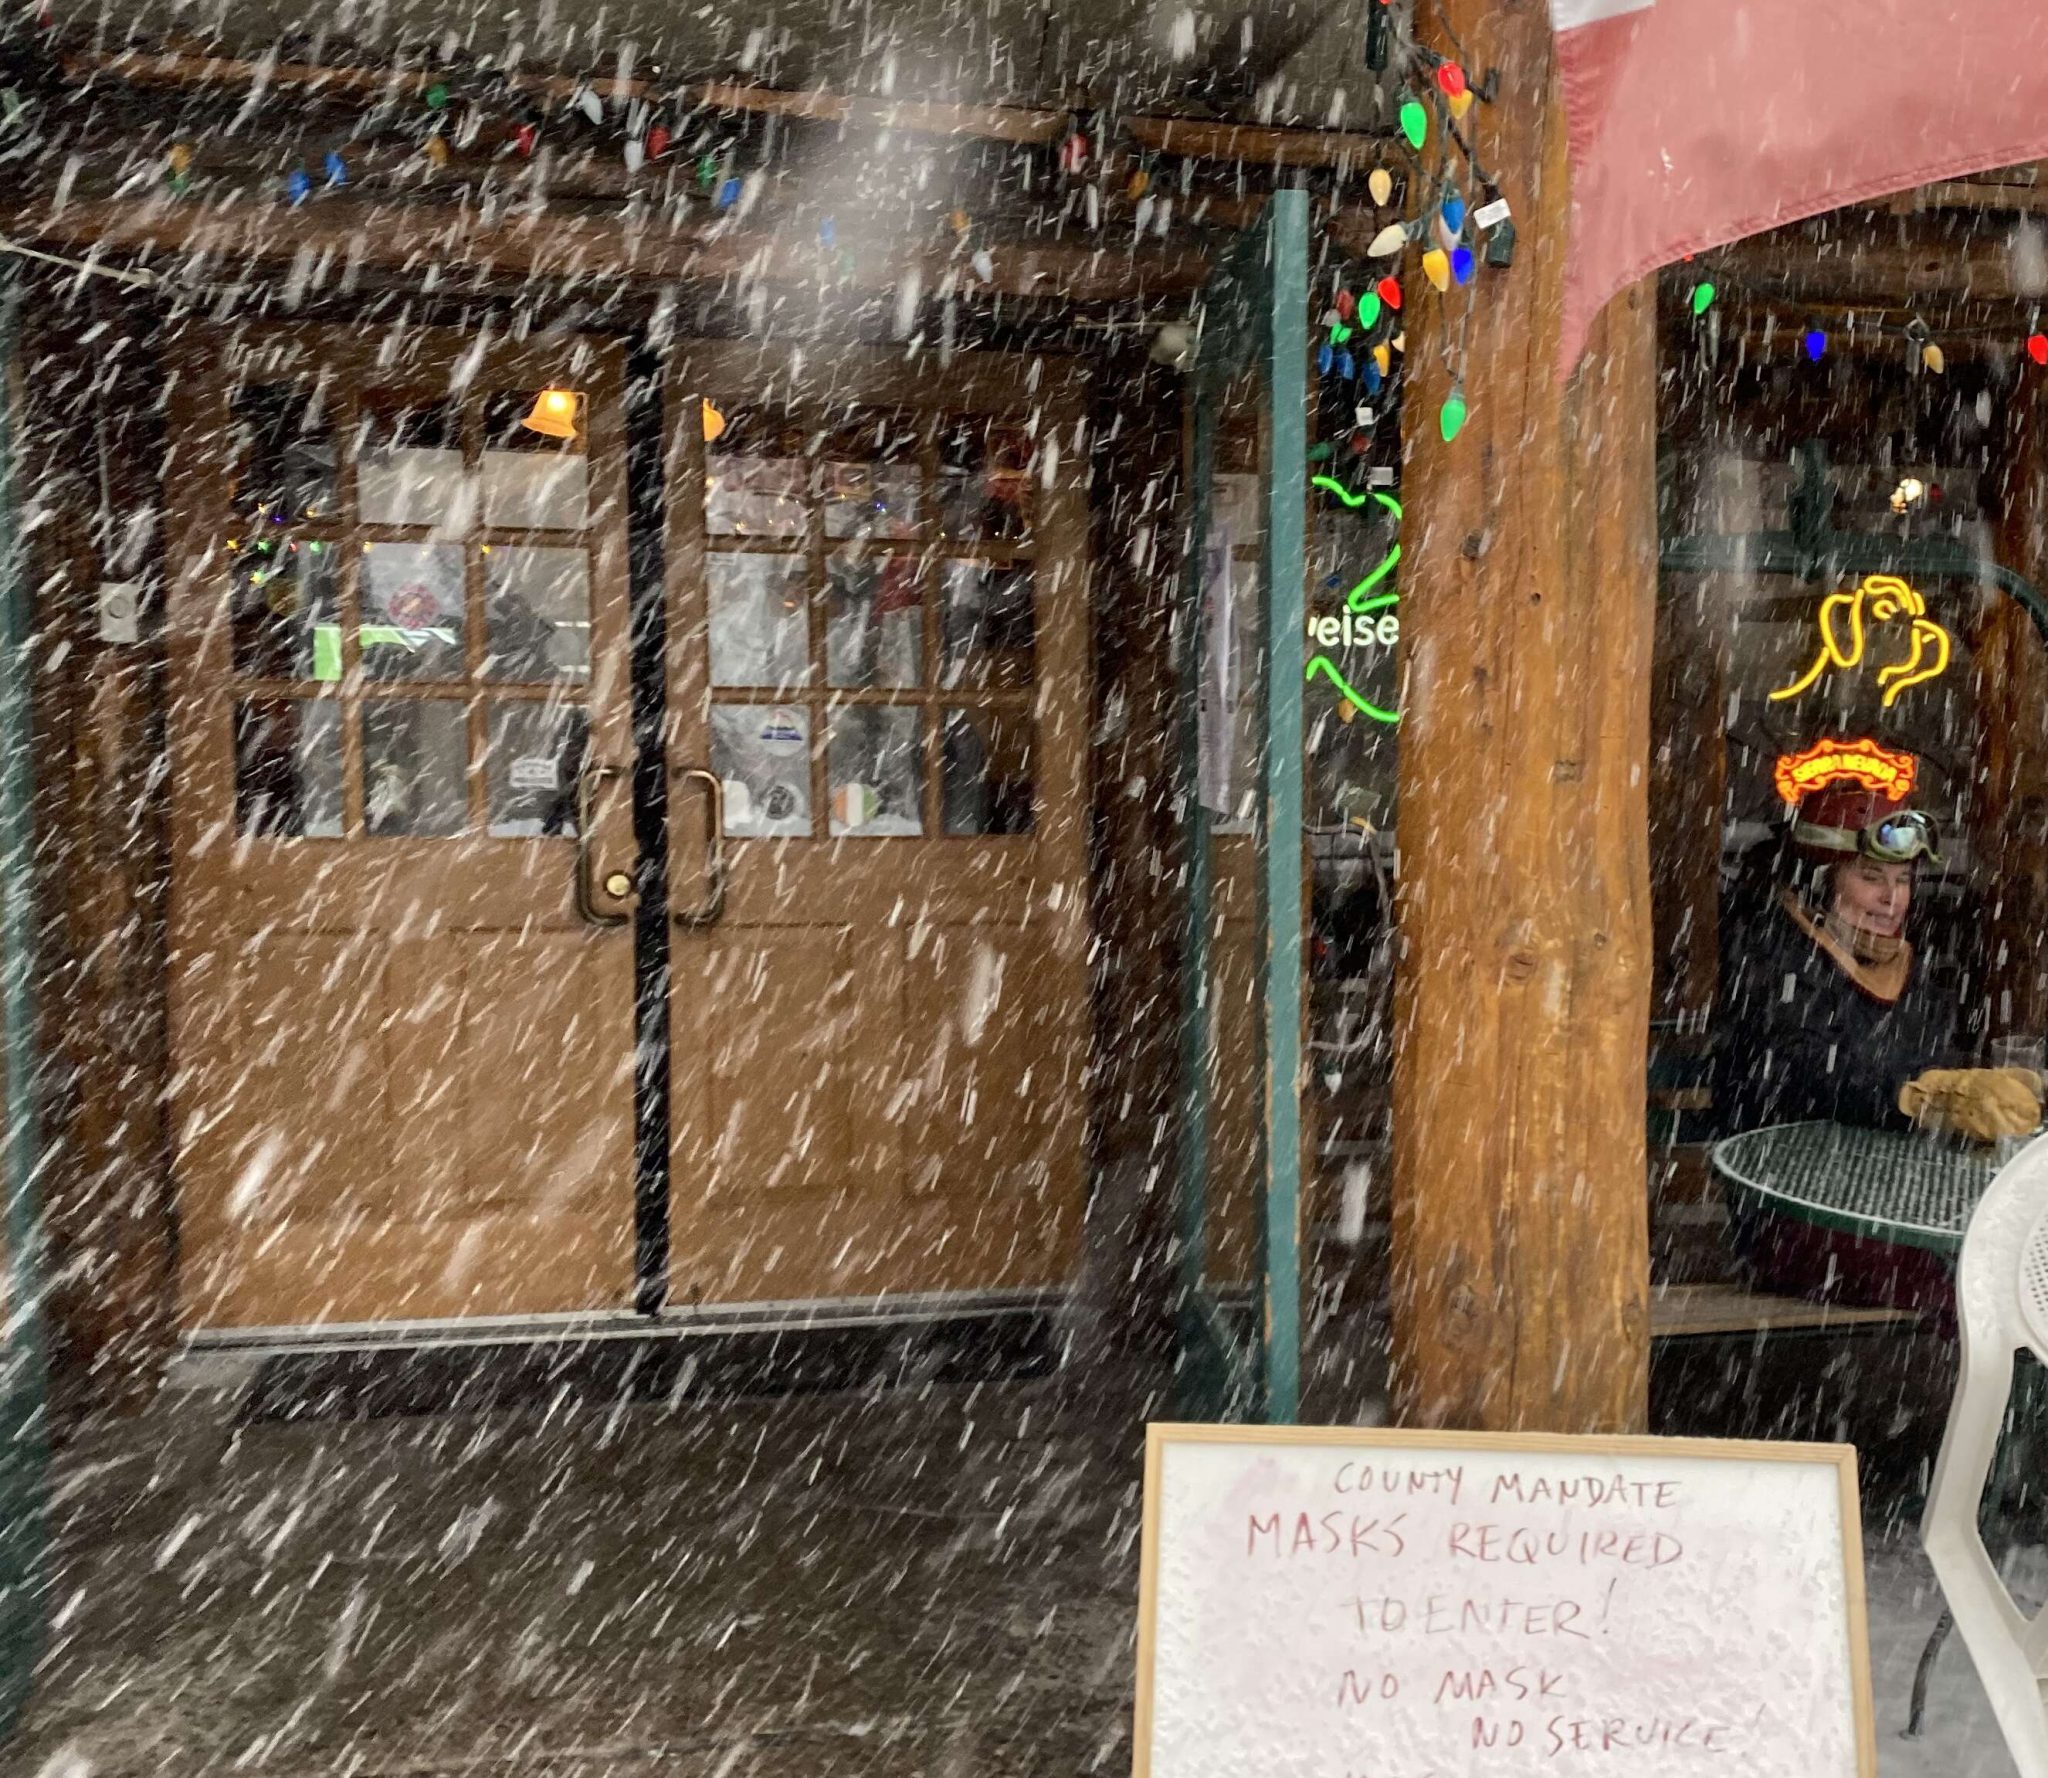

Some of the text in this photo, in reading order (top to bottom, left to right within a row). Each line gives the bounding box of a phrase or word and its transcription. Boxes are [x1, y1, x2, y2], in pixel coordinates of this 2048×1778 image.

[1333, 1461, 1685, 1509] COUNTY MANDATE
[1246, 1510, 1684, 1569] MASKS REQUIRED
[1339, 1577, 1617, 1640] TO ENTER!
[1338, 1666, 1568, 1707] NO MASK
[1471, 1716, 1524, 1749] NO
